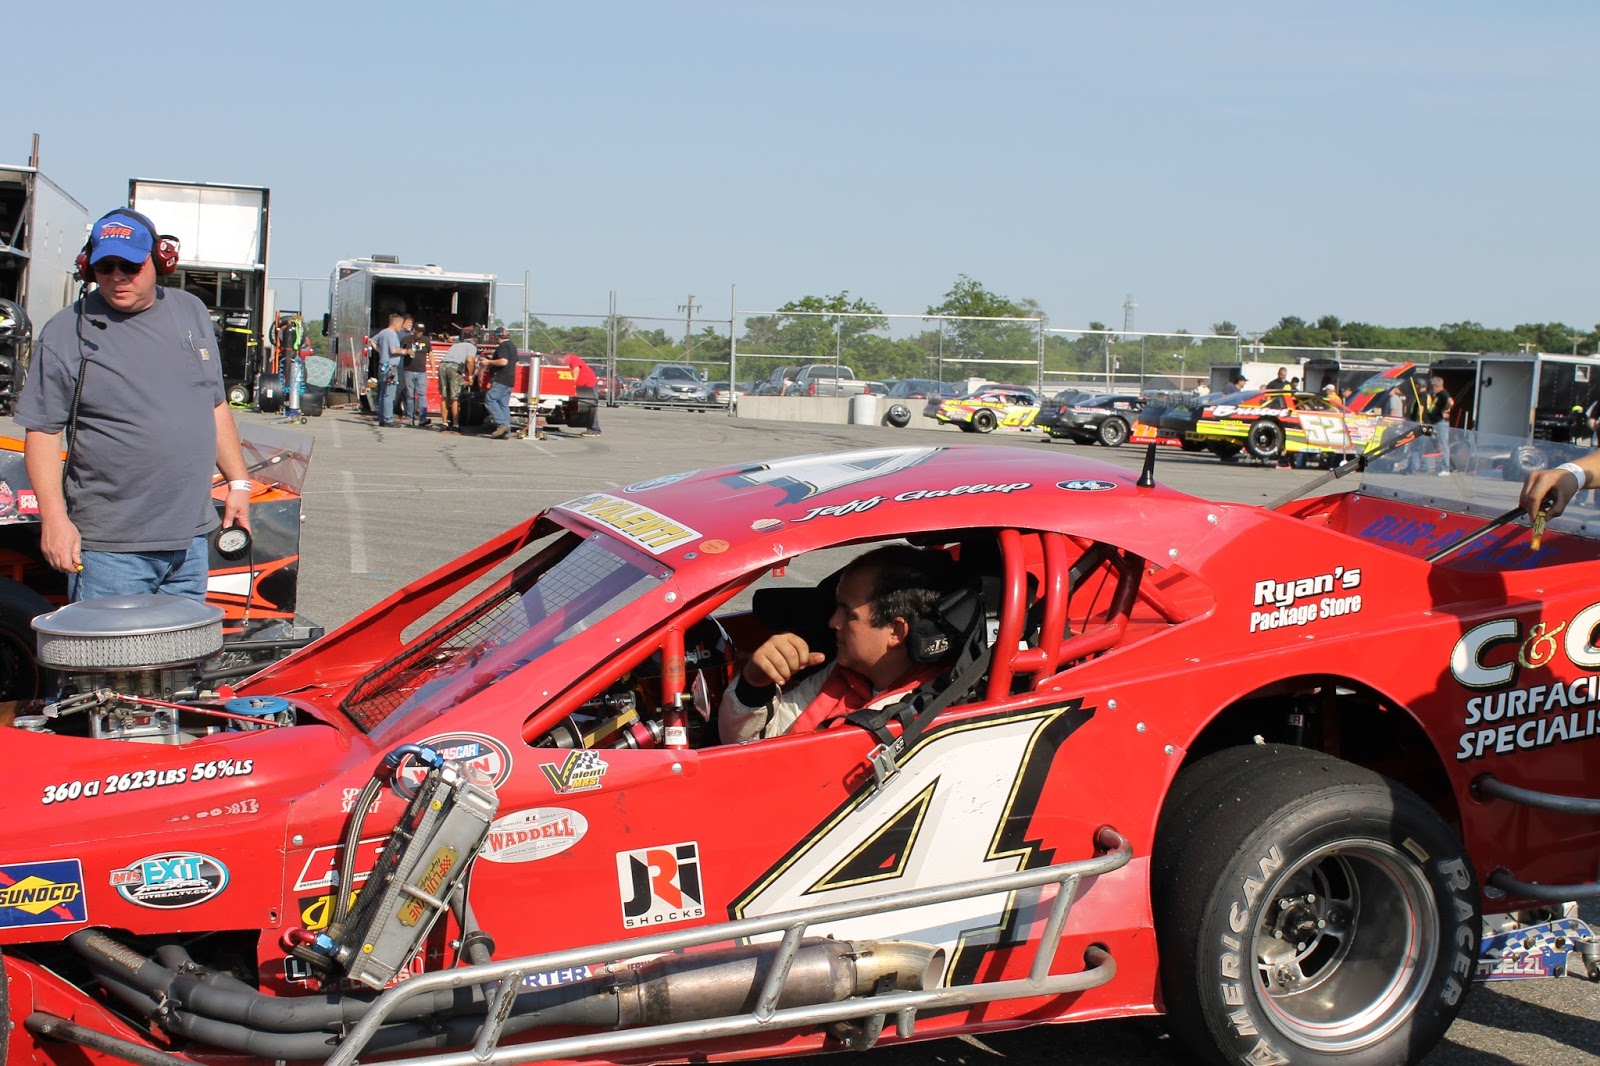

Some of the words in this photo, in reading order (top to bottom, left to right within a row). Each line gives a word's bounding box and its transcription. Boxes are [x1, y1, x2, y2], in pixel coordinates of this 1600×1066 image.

[1213, 405, 1290, 418] Bristol
[1303, 416, 1349, 448] 52
[790, 497, 887, 523] Jeff
[894, 481, 1034, 503] Gallup
[580, 497, 693, 549] VALENTI
[1254, 566, 1361, 608] Ryan's
[1249, 602, 1318, 633] Package
[1319, 594, 1362, 619] Store
[1450, 618, 1522, 690] C
[1518, 620, 1566, 669] &
[1464, 675, 1600, 726] SURFACI
[572, 777, 598, 789] MRS
[488, 817, 576, 852] WADDELL
[728, 699, 1080, 990] 4
[0, 885, 76, 905] SUNOCO
[626, 908, 703, 927] SHOCKS
[1439, 857, 1475, 1006] RACER
[1220, 843, 1290, 1066] AMERICAN
[523, 965, 587, 987] RTER
